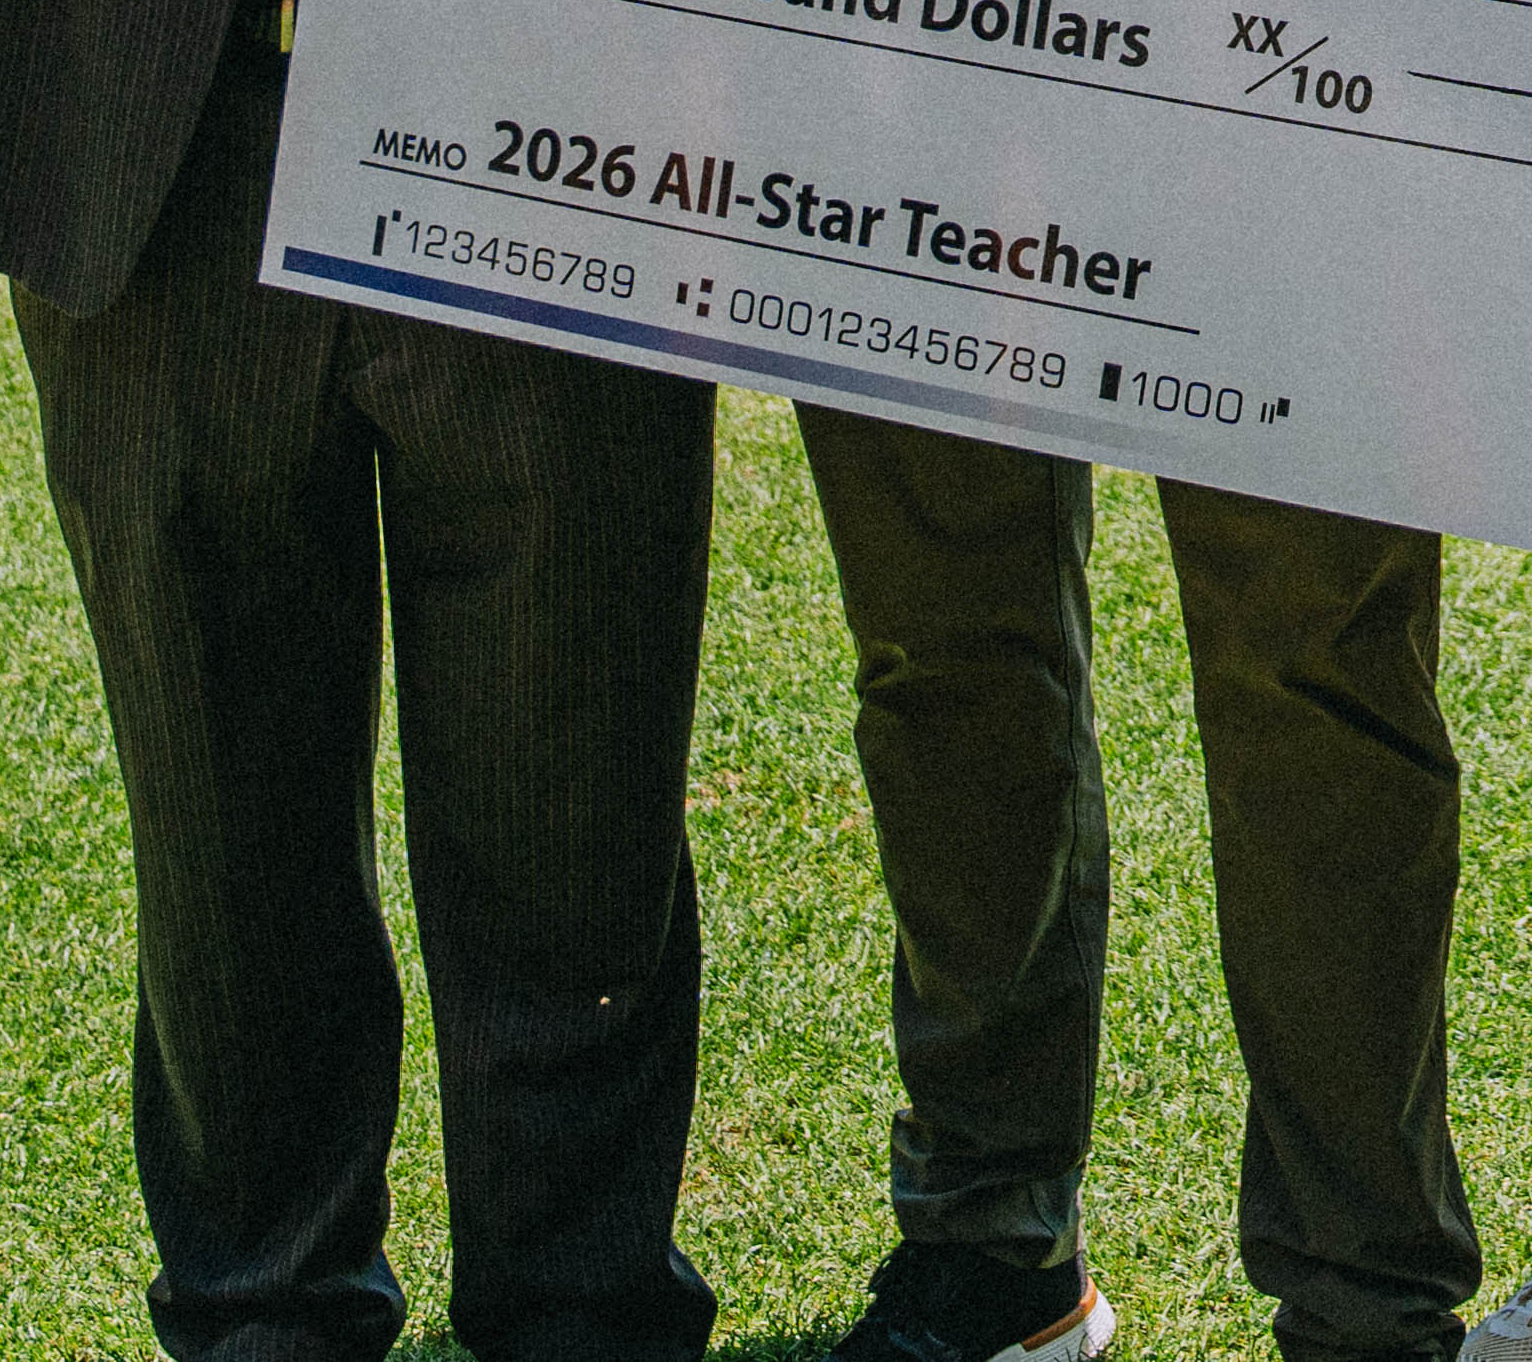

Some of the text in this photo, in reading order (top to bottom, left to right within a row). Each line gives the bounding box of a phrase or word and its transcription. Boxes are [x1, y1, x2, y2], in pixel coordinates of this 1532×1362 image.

[372, 119, 1153, 301] MEMO 2026 All-Star Teacher
[404, 219, 1244, 426] 123456789 000123456789 1000
